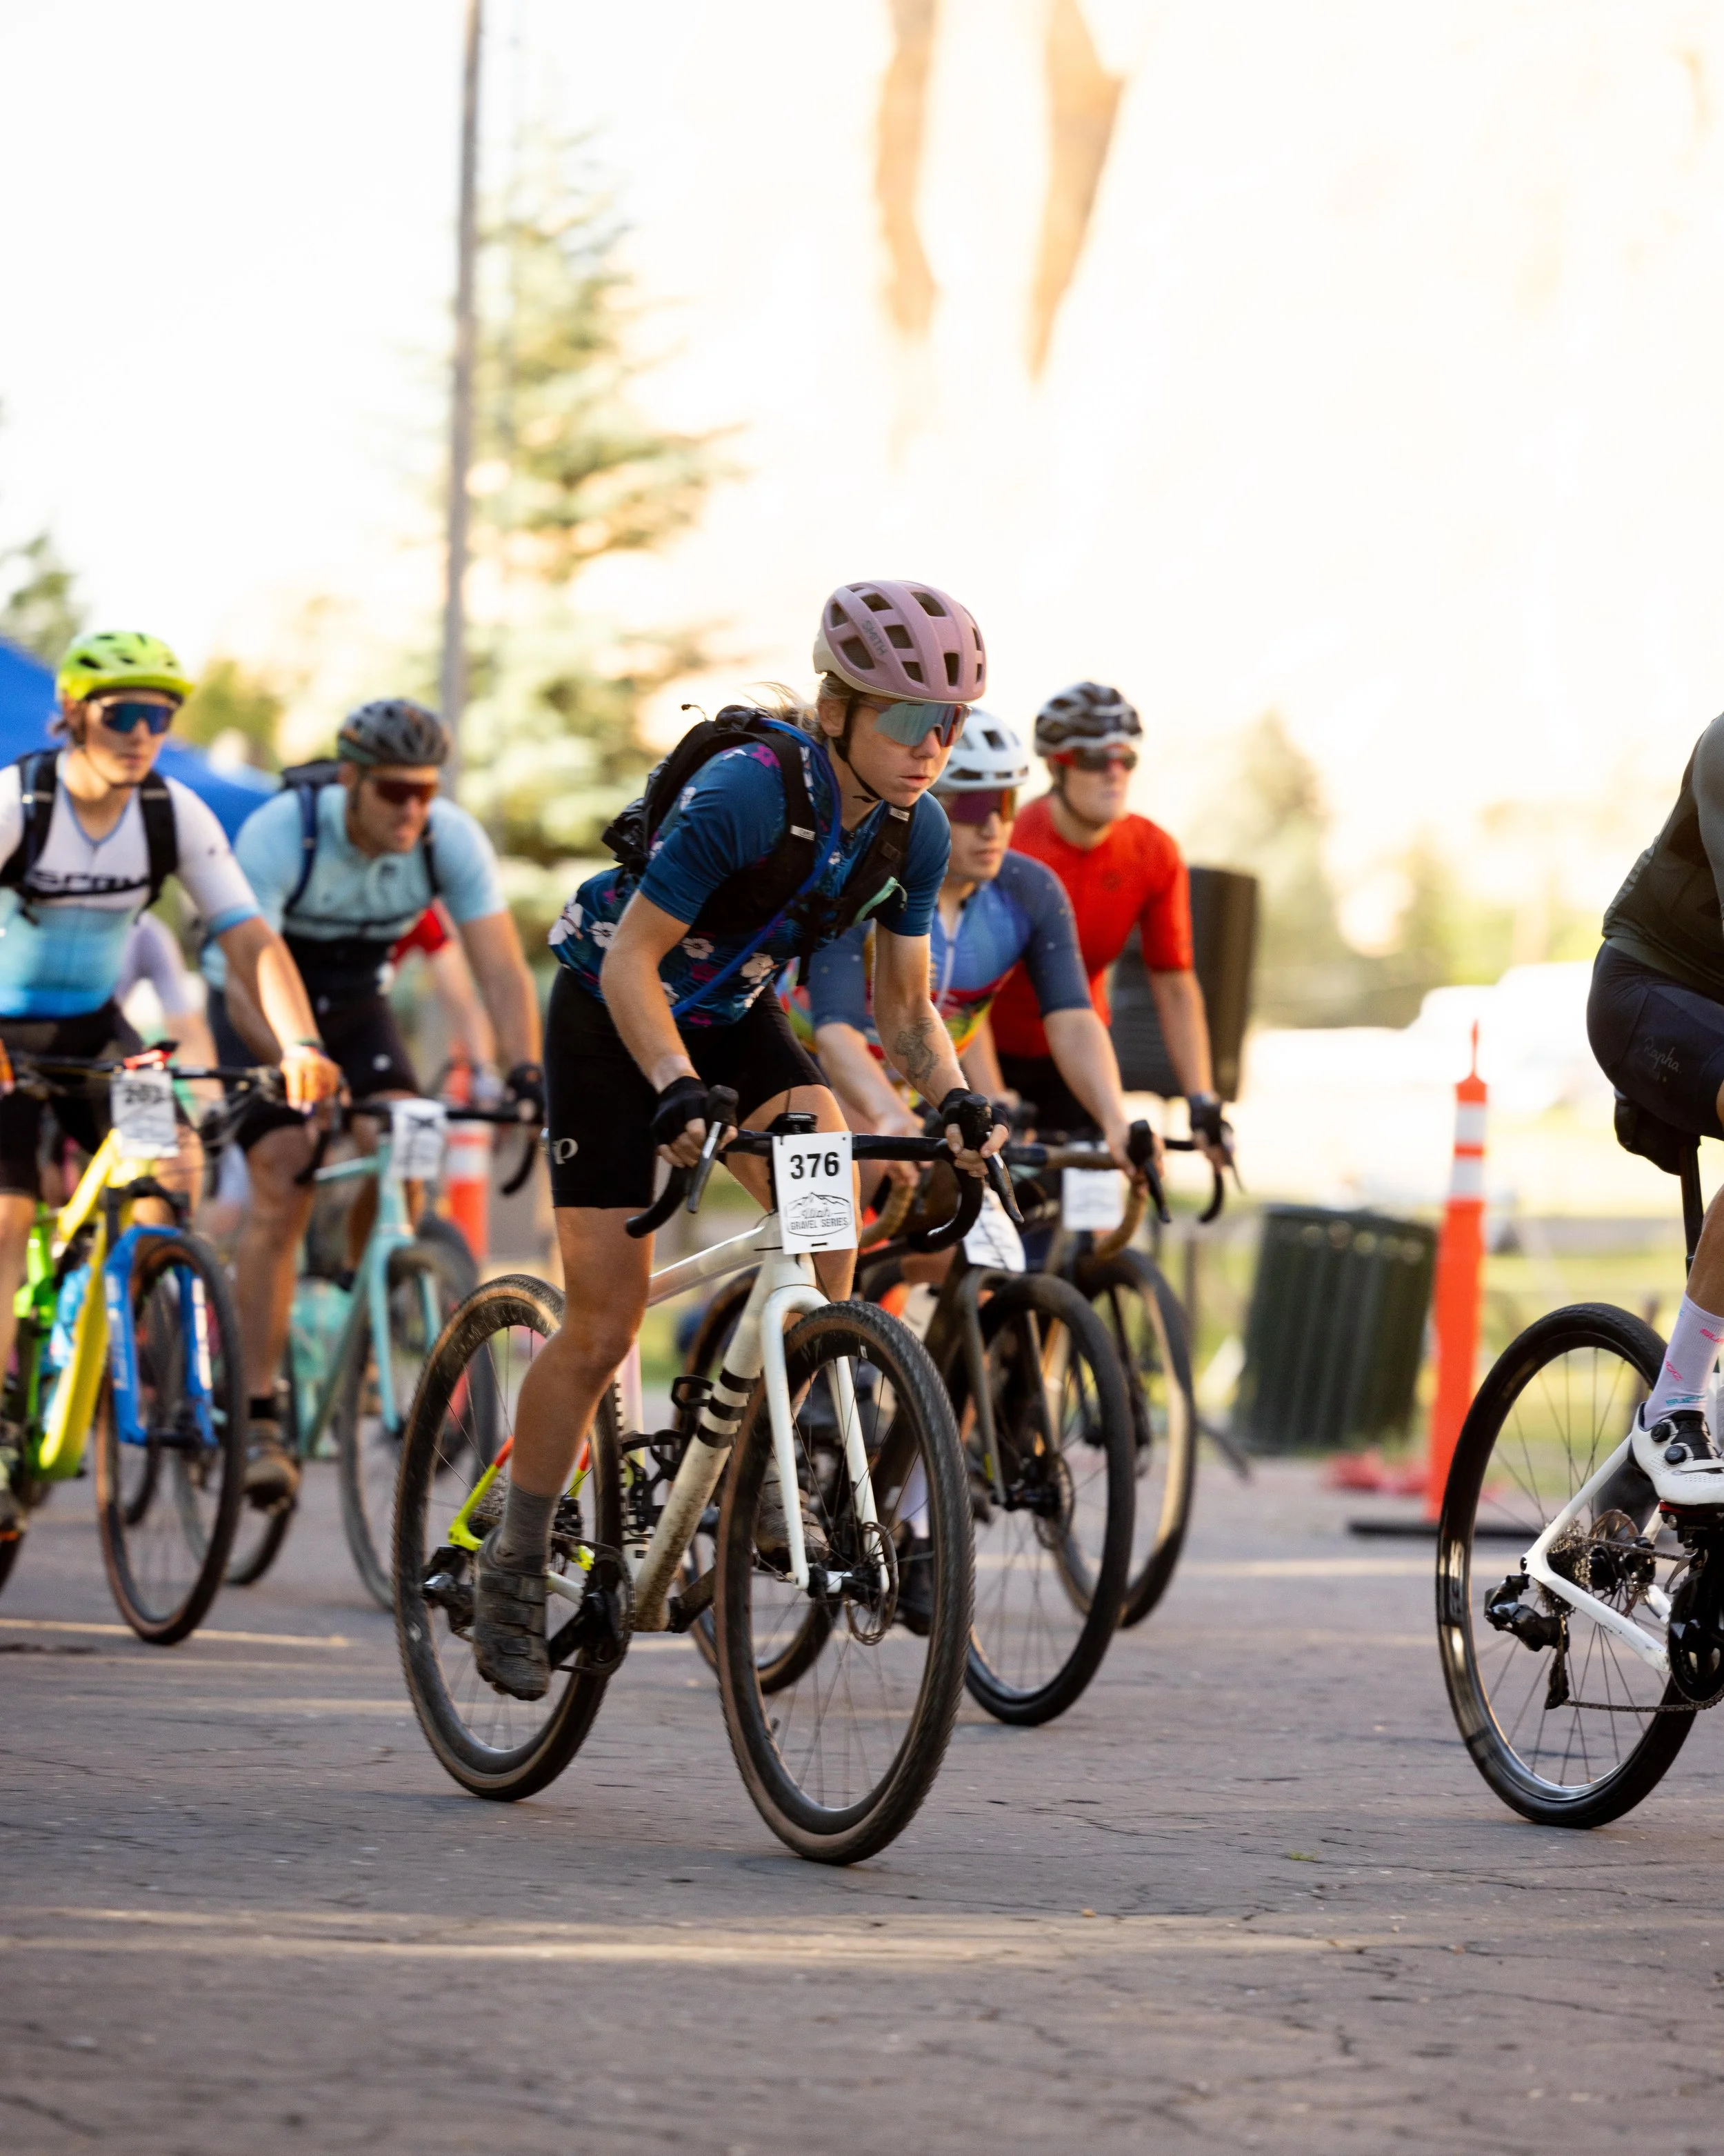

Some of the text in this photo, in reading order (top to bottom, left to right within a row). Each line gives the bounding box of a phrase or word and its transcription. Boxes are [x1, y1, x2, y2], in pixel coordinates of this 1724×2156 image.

[861, 619, 888, 656] SMITH
[790, 1152, 839, 1179] 376
[790, 1217, 848, 1230] GRAVEL SERIES
